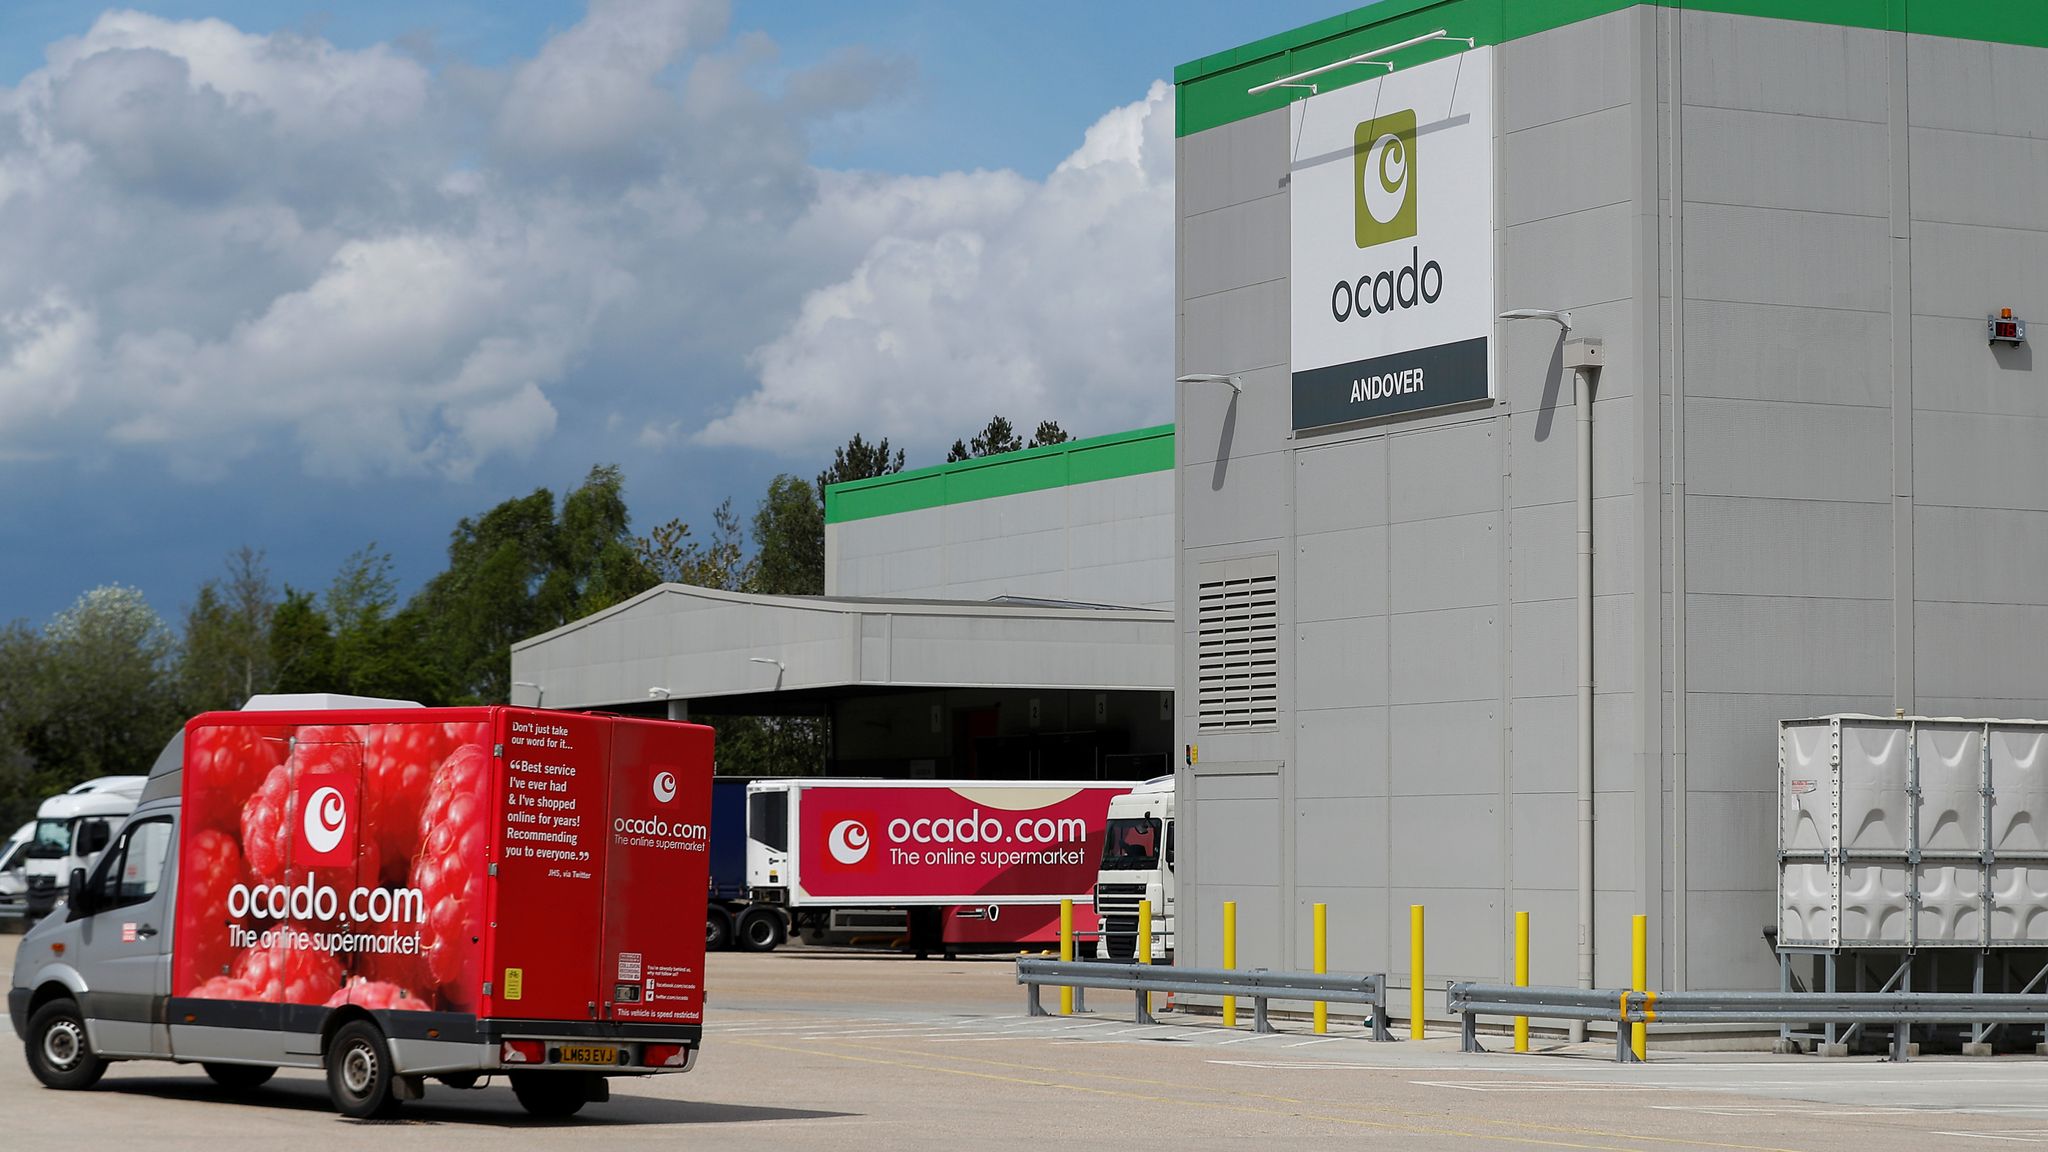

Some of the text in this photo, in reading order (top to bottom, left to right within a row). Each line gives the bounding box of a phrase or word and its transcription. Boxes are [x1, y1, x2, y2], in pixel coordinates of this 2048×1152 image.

[1331, 246, 1443, 323] ocado
[1350, 367, 1425, 403] ANDOVER
[1032, 707, 1038, 719] 2
[512, 722, 568, 736] Don't just take
[511, 736, 574, 750] our word for it...
[544, 764, 576, 776] service
[509, 776, 567, 792] I've ever had
[508, 793, 576, 811] & I've shopped
[507, 811, 580, 828] online for years!
[614, 815, 706, 840] ocado.com
[888, 809, 1086, 843] ocado.com
[507, 827, 578, 846] Recommending
[614, 834, 705, 852] The online supermarket
[505, 846, 522, 858] you
[525, 846, 534, 857] to
[890, 848, 1085, 868] The online supermarket
[562, 870, 571, 878] via
[572, 870, 591, 879] Twitter
[227, 871, 424, 923] ocado.com
[228, 924, 421, 957] The online supermarket
[617, 1008, 700, 1019] This vehicle is speed restricted
